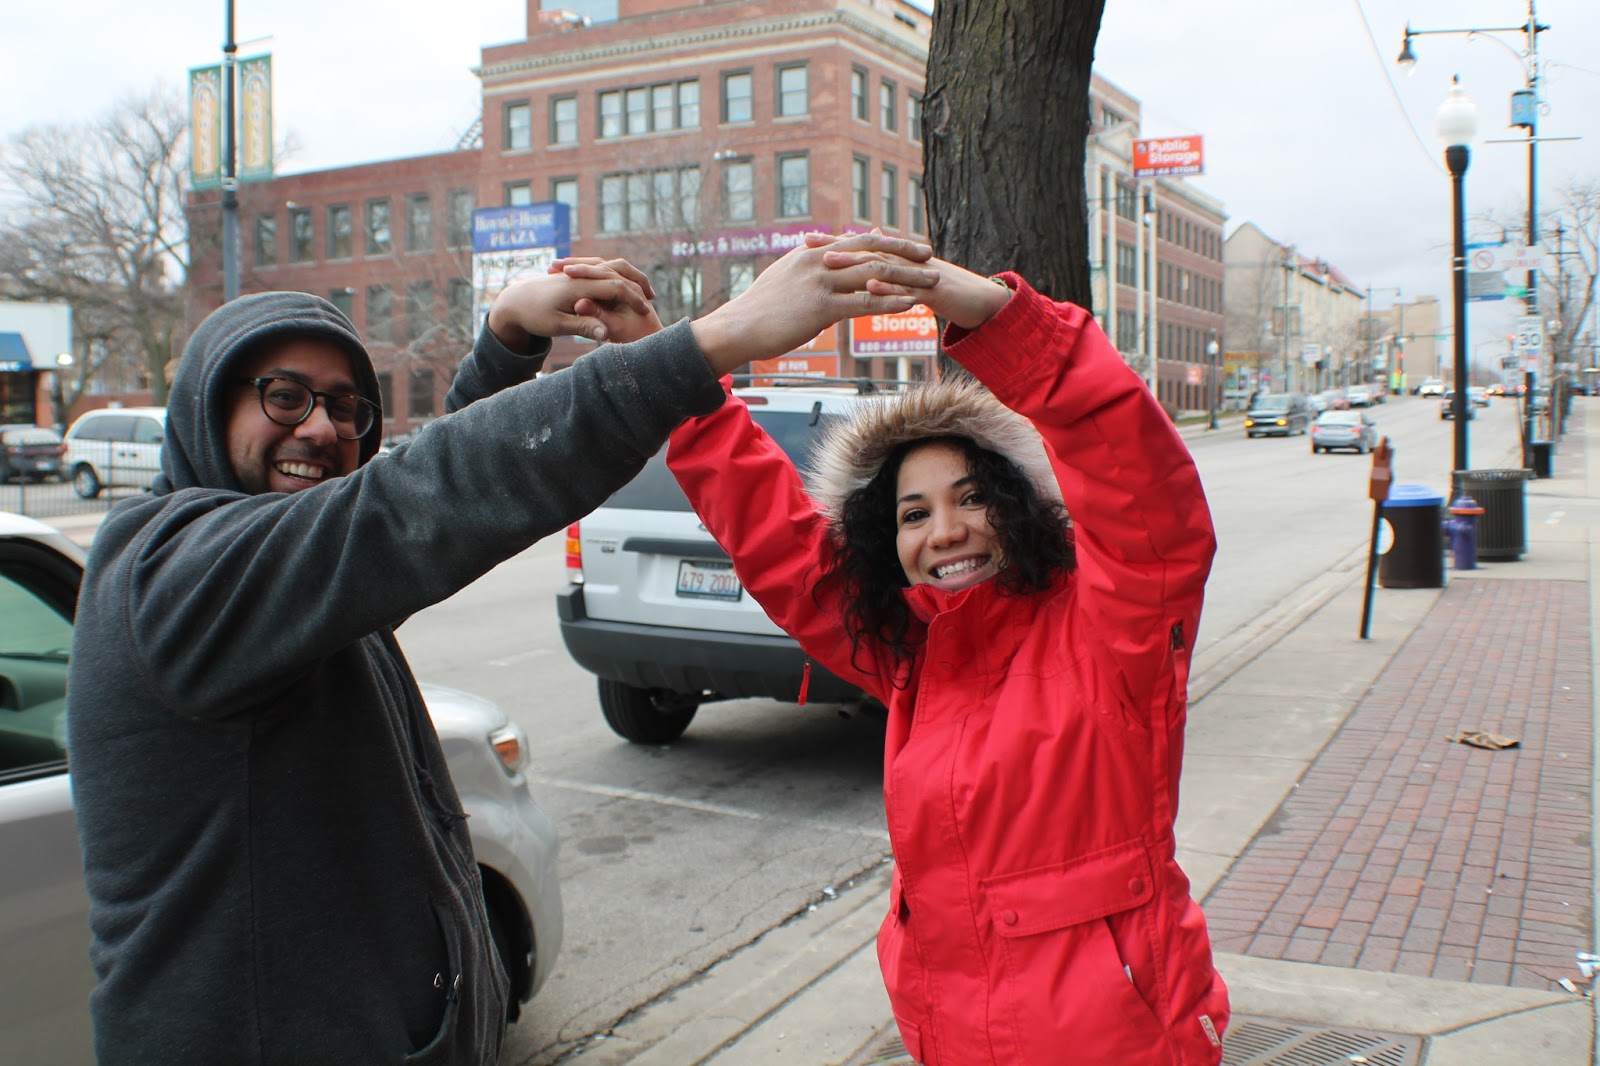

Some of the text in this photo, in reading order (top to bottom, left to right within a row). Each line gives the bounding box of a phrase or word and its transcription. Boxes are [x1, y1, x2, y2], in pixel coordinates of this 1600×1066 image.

[1149, 139, 1190, 152] Public
[1148, 151, 1200, 165] Storage
[490, 229, 537, 247] PLAZA
[1519, 333, 1541, 346] 30
[681, 571, 704, 590] 479
